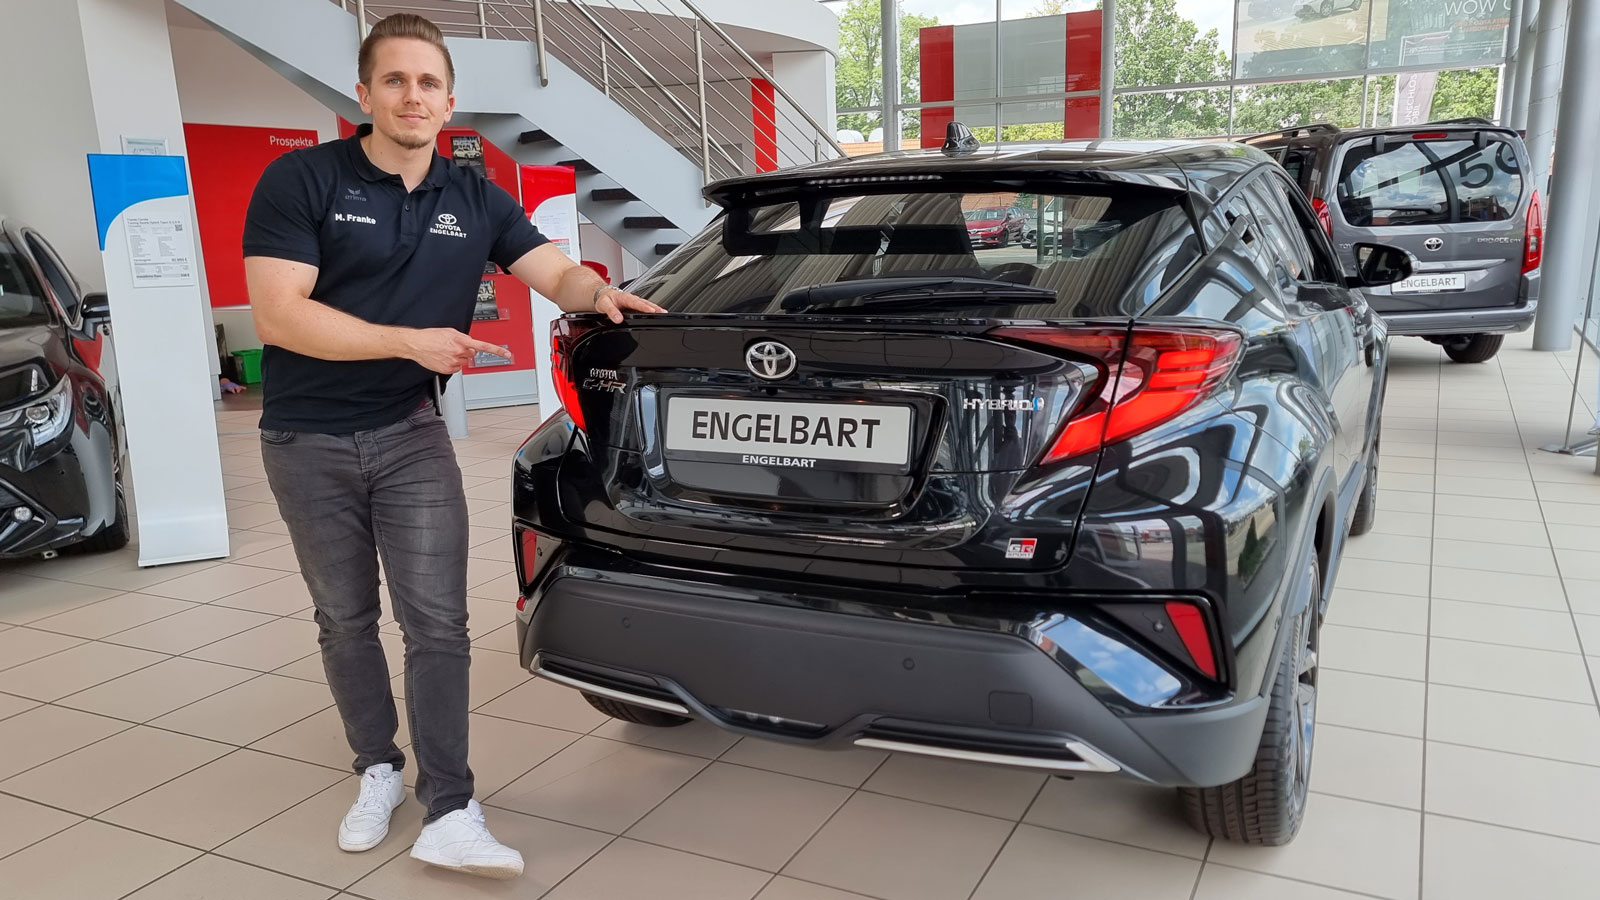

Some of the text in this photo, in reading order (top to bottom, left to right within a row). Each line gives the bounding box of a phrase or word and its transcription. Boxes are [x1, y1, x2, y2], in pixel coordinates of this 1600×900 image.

[1445, 0, 1497, 16] WOW
[1405, 73, 1417, 125] UNSCHLOS
[1411, 103, 1421, 125] OBIL
[269, 135, 314, 148] Prospekte
[334, 213, 377, 225] M. Franke
[429, 227, 467, 239] ENGELBART
[434, 223, 461, 232] TOYOTA
[1401, 277, 1457, 288] ENGELBART
[590, 367, 618, 380] TOYOTA
[583, 378, 627, 394] C-HR
[963, 397, 1033, 411] HYBRID
[692, 410, 881, 449] ENGELBART
[742, 454, 816, 468] ENGELBART
[1008, 543, 1034, 553] GR
